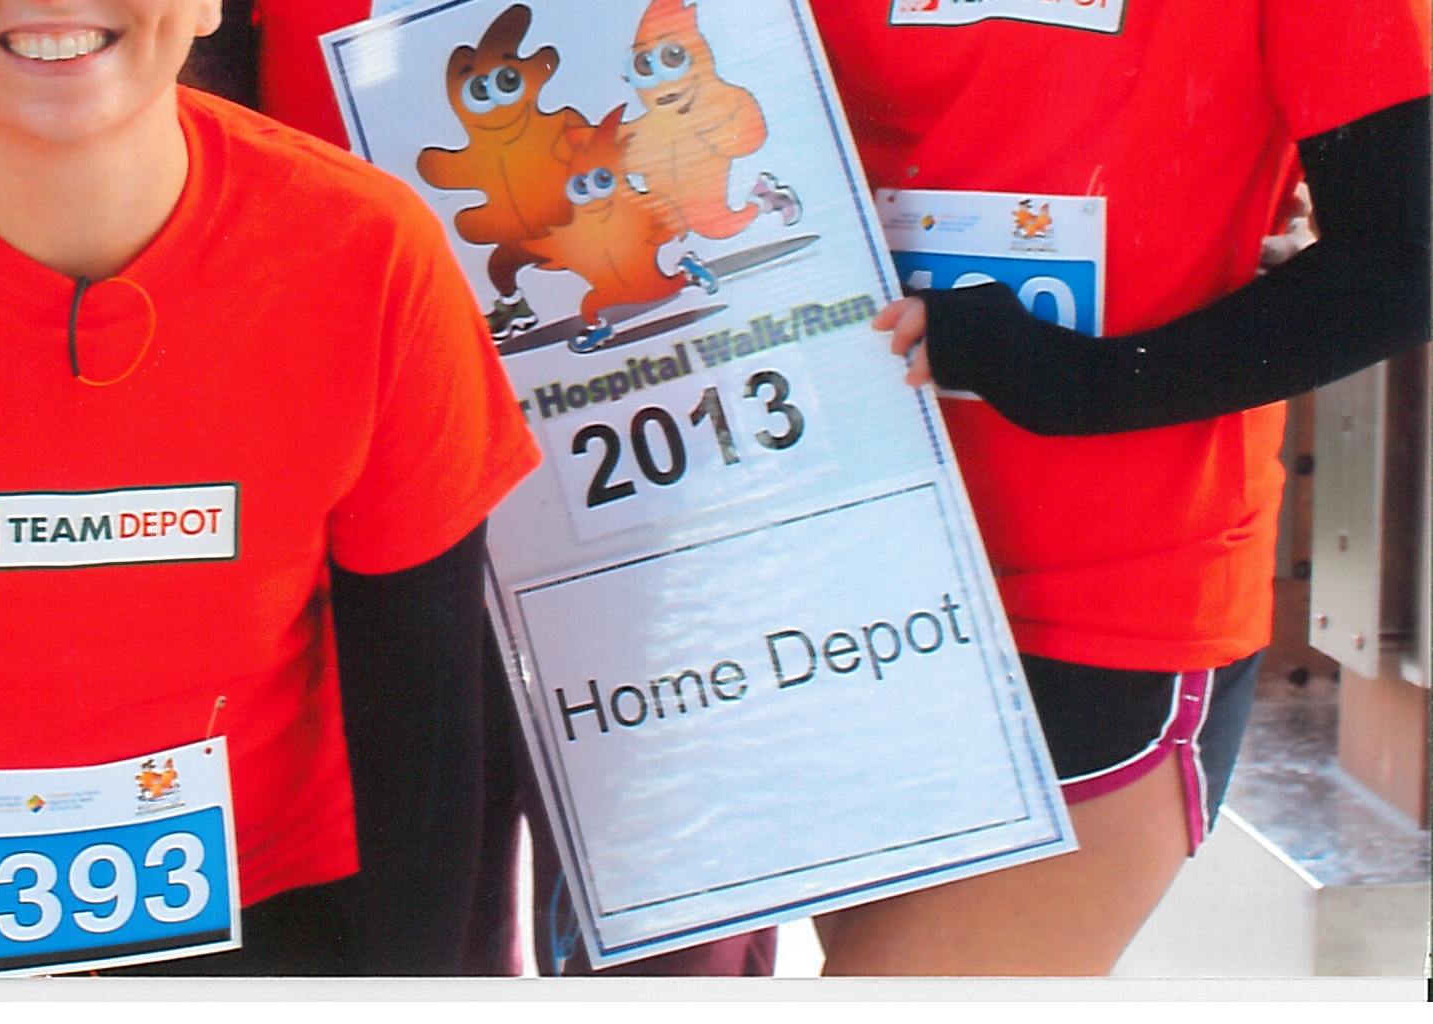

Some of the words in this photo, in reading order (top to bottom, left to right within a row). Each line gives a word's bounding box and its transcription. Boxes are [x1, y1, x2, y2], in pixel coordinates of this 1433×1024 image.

[534, 343, 692, 419] Hospital
[695, 292, 878, 367] Walk/Run
[571, 370, 805, 508] 2013
[8, 514, 113, 543] TEAM
[119, 508, 222, 539] DEPOT
[555, 658, 748, 741] Home
[766, 592, 970, 690] Depot
